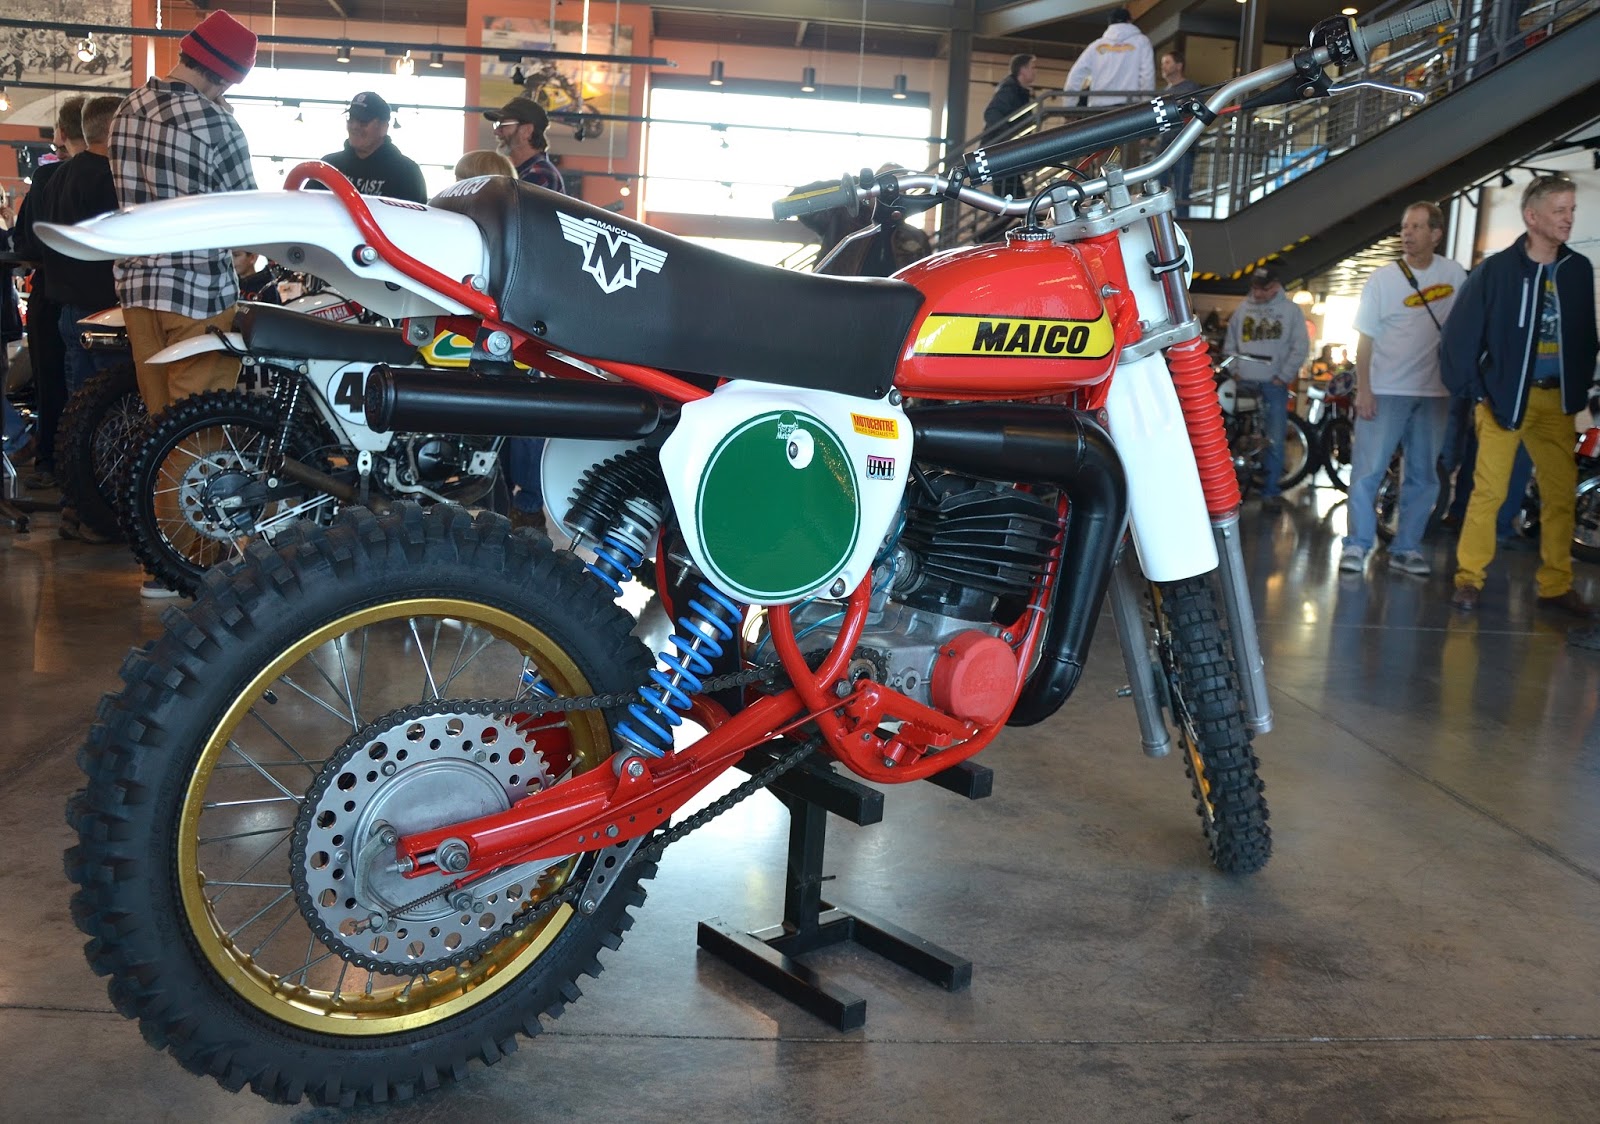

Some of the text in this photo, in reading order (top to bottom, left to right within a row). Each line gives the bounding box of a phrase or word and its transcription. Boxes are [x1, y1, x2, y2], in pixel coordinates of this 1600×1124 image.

[440, 177, 491, 198] MAICO
[597, 220, 628, 237] MAICO
[315, 304, 349, 322] YAMAHA
[972, 321, 1090, 354] MAICO
[853, 414, 895, 432] MOTOCENTRE
[869, 458, 892, 476] UNI
